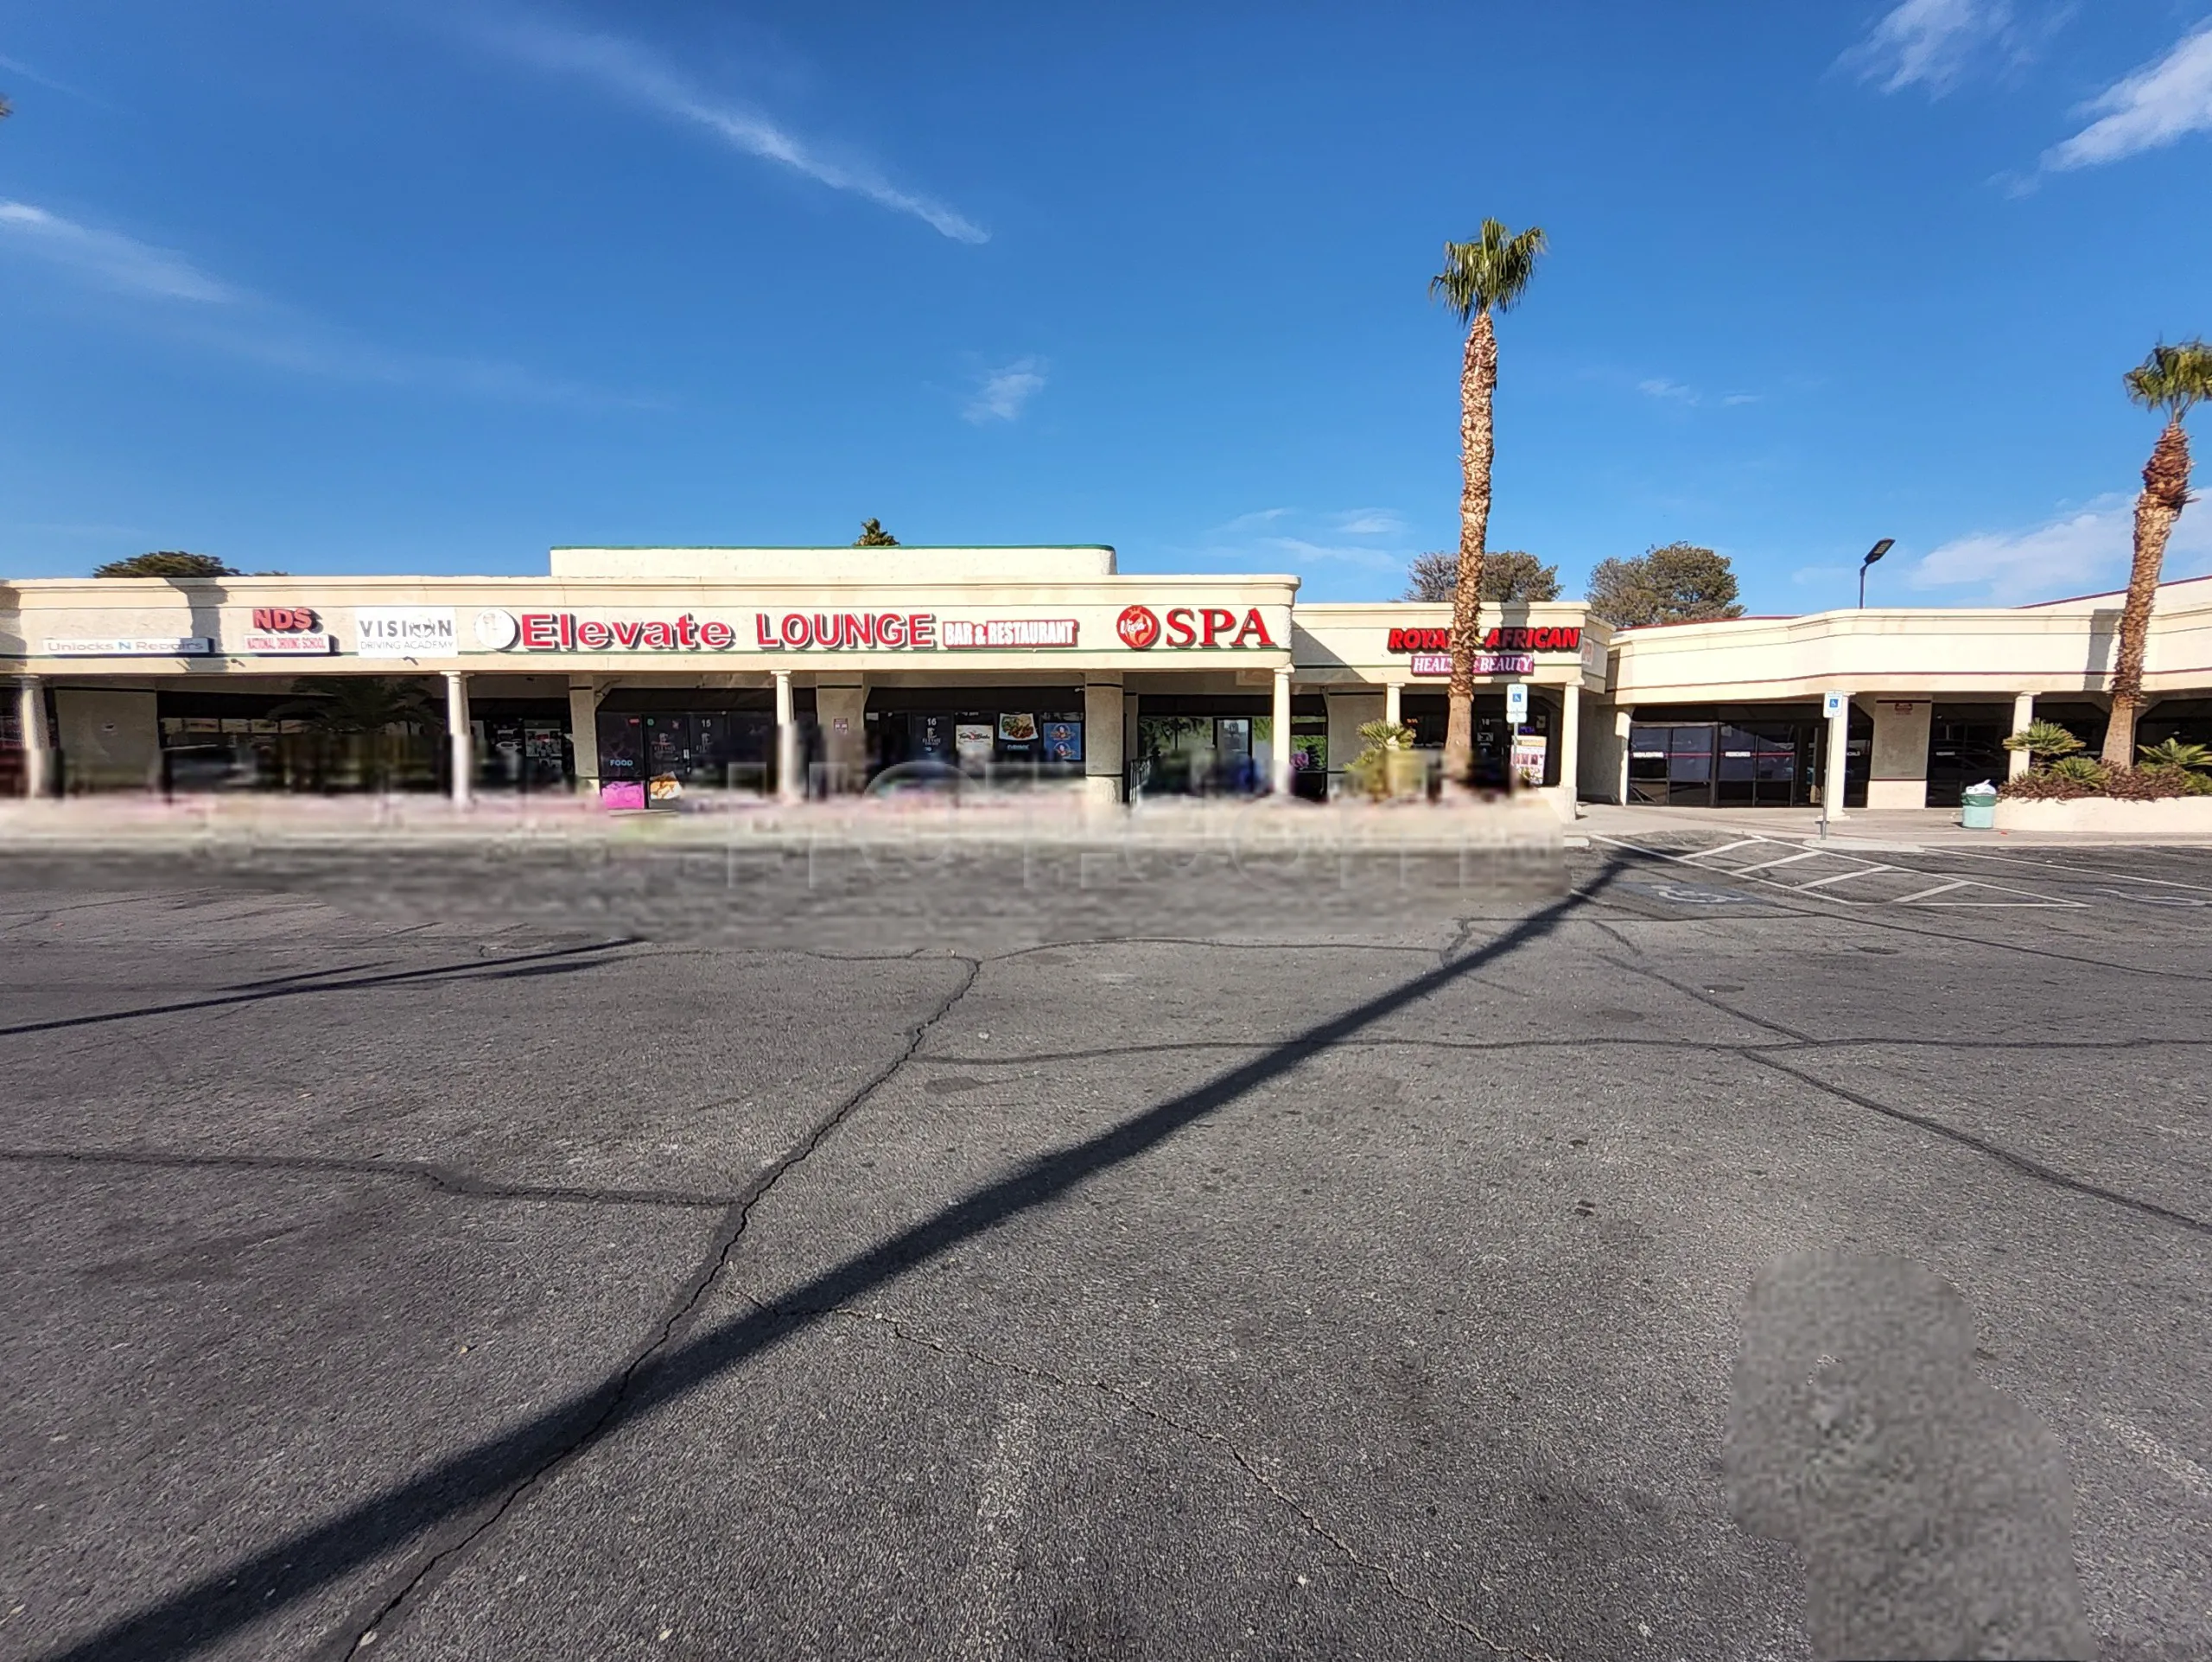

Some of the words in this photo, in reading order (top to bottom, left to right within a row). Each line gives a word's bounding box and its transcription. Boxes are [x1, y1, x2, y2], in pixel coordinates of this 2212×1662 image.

[252, 608, 312, 629] NDS
[1166, 608, 1272, 646] SPA
[359, 619, 453, 638] VISION
[521, 614, 731, 647] Elevate
[756, 613, 932, 646] LOUNGE
[944, 622, 973, 646] BAR
[975, 626, 987, 646] &
[987, 620, 1076, 645] RESTAURANT
[360, 641, 401, 650] DRIVING
[404, 640, 454, 649] ACADEMY
[1485, 627, 1580, 648] AFRICAN
[48, 641, 114, 652] Unlocks
[118, 641, 132, 651] N
[136, 641, 204, 653] Repairs
[1413, 657, 1453, 672] HEAL
[1479, 656, 1532, 672] BEAUTY
[927, 717, 937, 726] 16
[609, 759, 633, 767] FOOD
